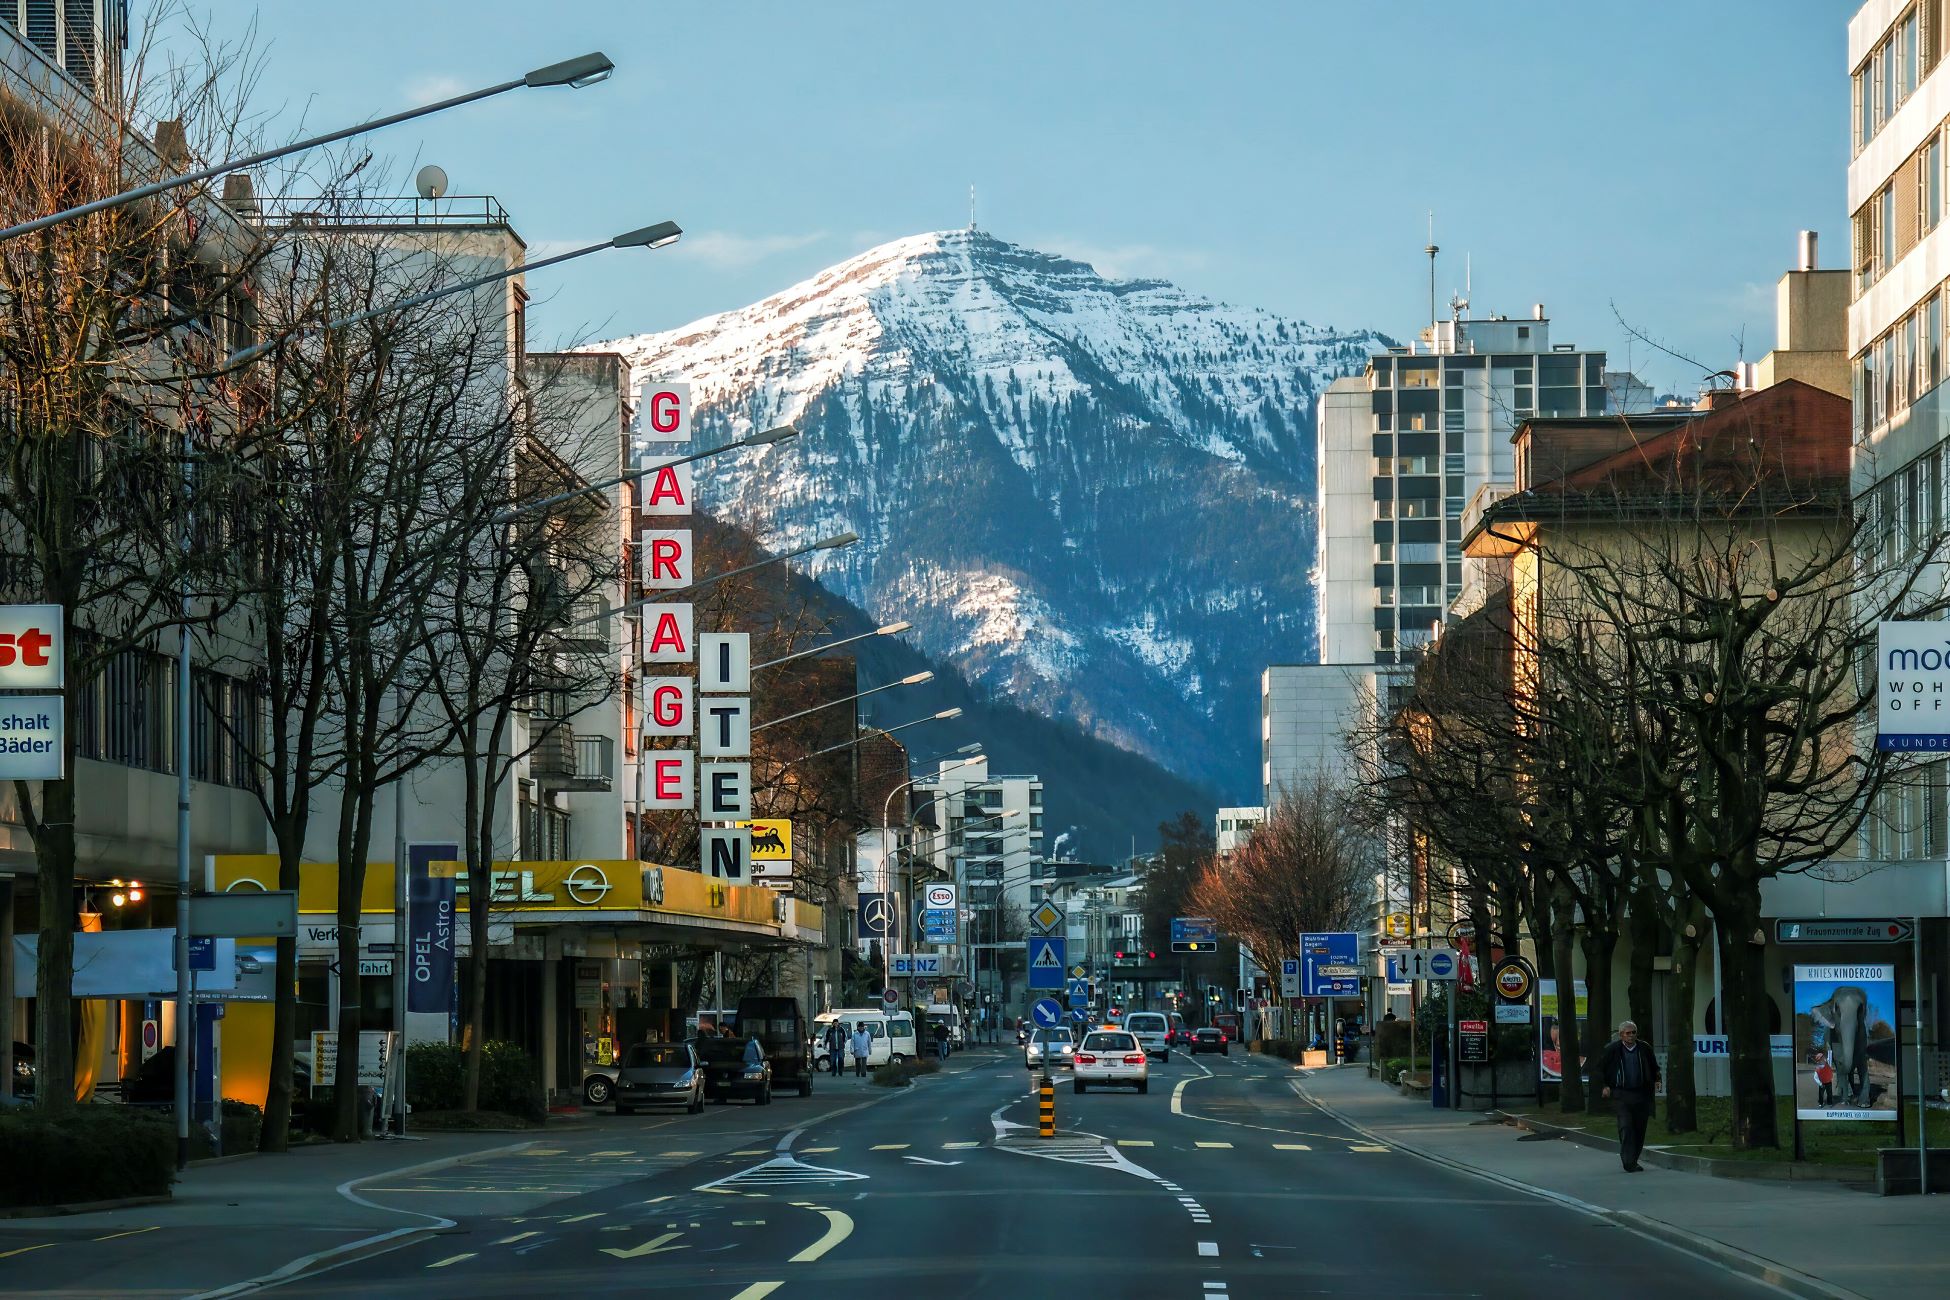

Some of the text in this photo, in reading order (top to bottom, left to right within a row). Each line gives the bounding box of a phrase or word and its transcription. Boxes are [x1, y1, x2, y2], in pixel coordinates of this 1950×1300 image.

[649, 391, 686, 800] GARAGE
[1889, 641, 1950, 671] mo
[1890, 699, 1942, 711] OFF
[0, 736, 53, 754] Bäder
[1888, 738, 1949, 747] KUNDE
[709, 642, 741, 879] ITEN
[308, 927, 364, 941] Verkf
[433, 900, 451, 953] Astra
[1866, 926, 1882, 937] Zug
[414, 931, 432, 984] OPEL
[1833, 967, 1883, 979] KINDERZOO
